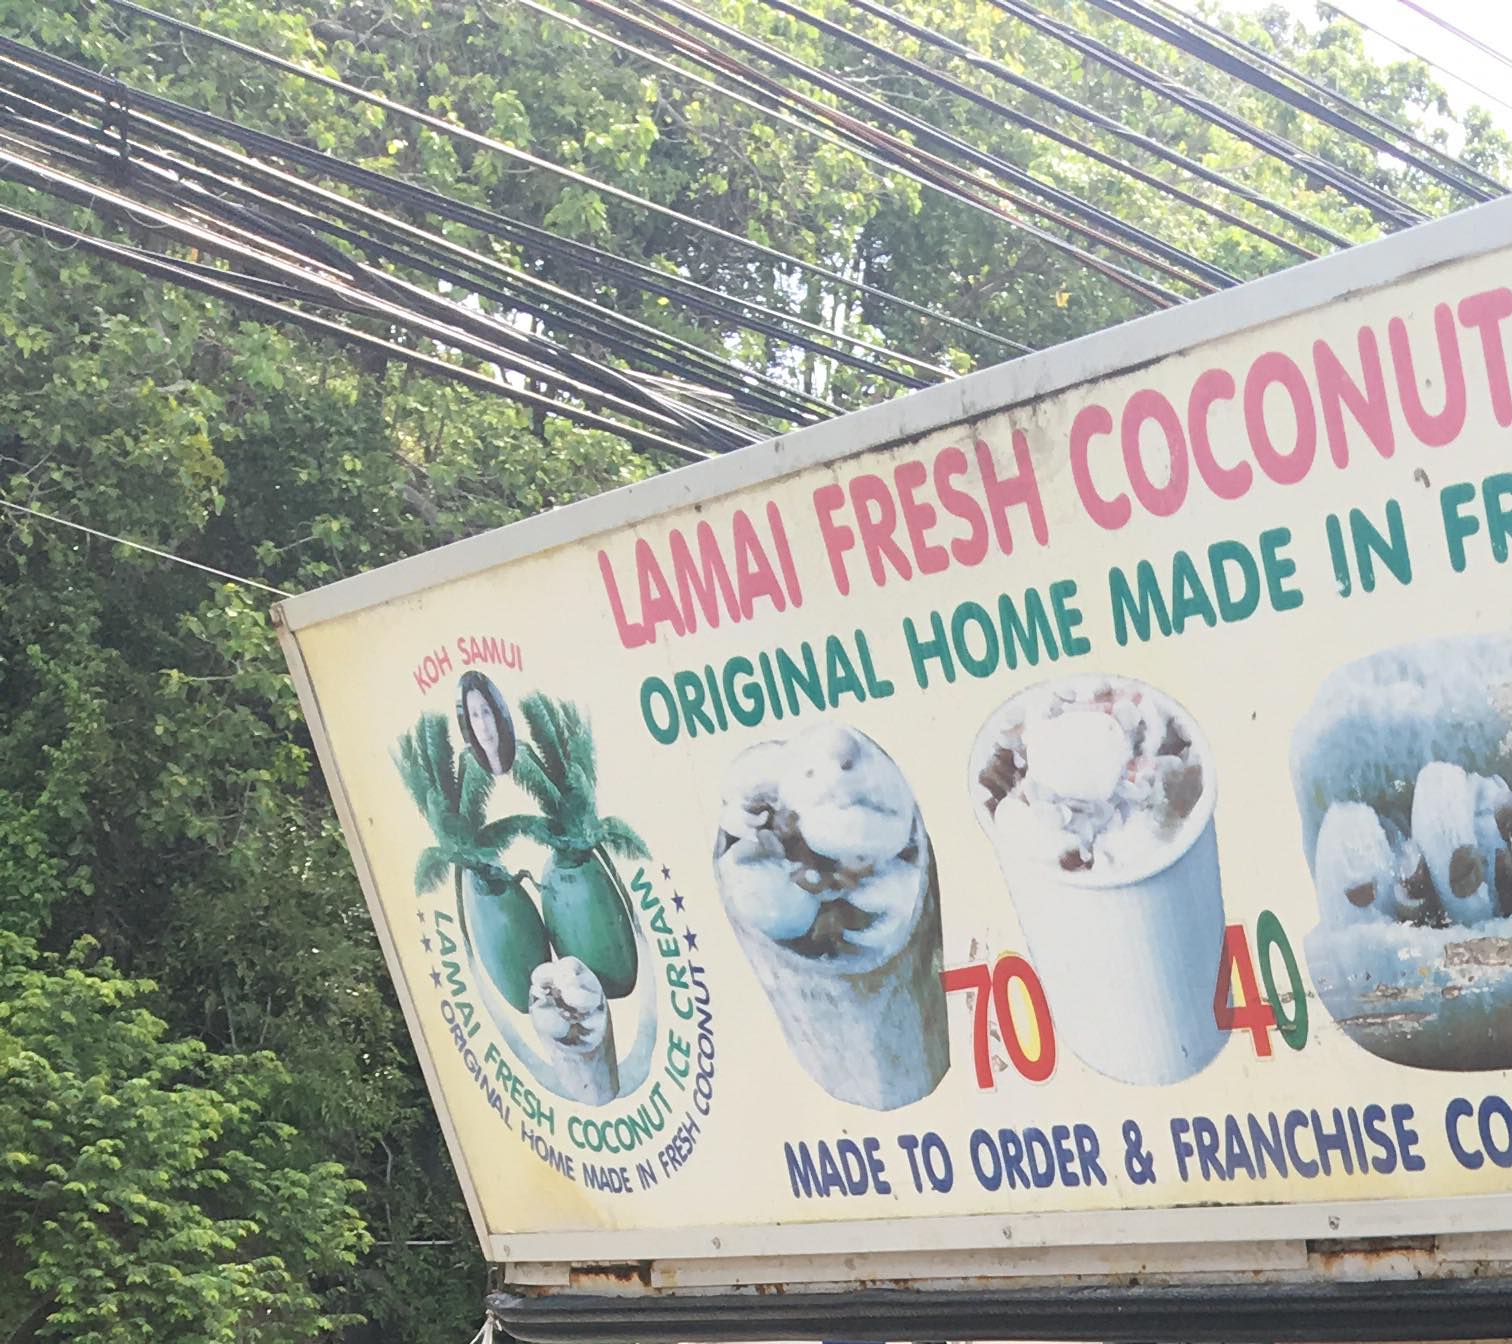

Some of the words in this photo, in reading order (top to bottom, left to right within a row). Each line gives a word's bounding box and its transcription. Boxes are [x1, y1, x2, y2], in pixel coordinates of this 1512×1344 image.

[598, 501, 803, 648] LAMAI
[814, 431, 1049, 597] FRESH
[413, 646, 453, 695] KOH
[457, 636, 523, 672] SAMUI
[640, 630, 894, 744] ORIGINAL
[903, 579, 1091, 689] HOME
[1108, 526, 1304, 647] MADE
[1325, 498, 1412, 598] IN
[434, 910, 481, 1038] LAMAI
[630, 867, 694, 1021] CREAM
[1213, 910, 1307, 1057] 40
[440, 999, 513, 1131] ORIGINAL
[521, 1119, 576, 1181] HOME
[582, 1161, 634, 1194] MADE
[635, 1158, 658, 1190] IN
[657, 1111, 701, 1179] FRESH
[691, 959, 716, 1117] COCONUT
[664, 1028, 691, 1091] ICE
[942, 953, 1057, 1089] 70
[484, 1042, 555, 1135] FRESH
[568, 1082, 673, 1154] COCONUT
[785, 1138, 891, 1199] MADE
[898, 1131, 954, 1193] TO
[970, 1123, 1107, 1190] ORDER
[1124, 1119, 1156, 1185] &
[1170, 1102, 1426, 1181] FRANCHISE
